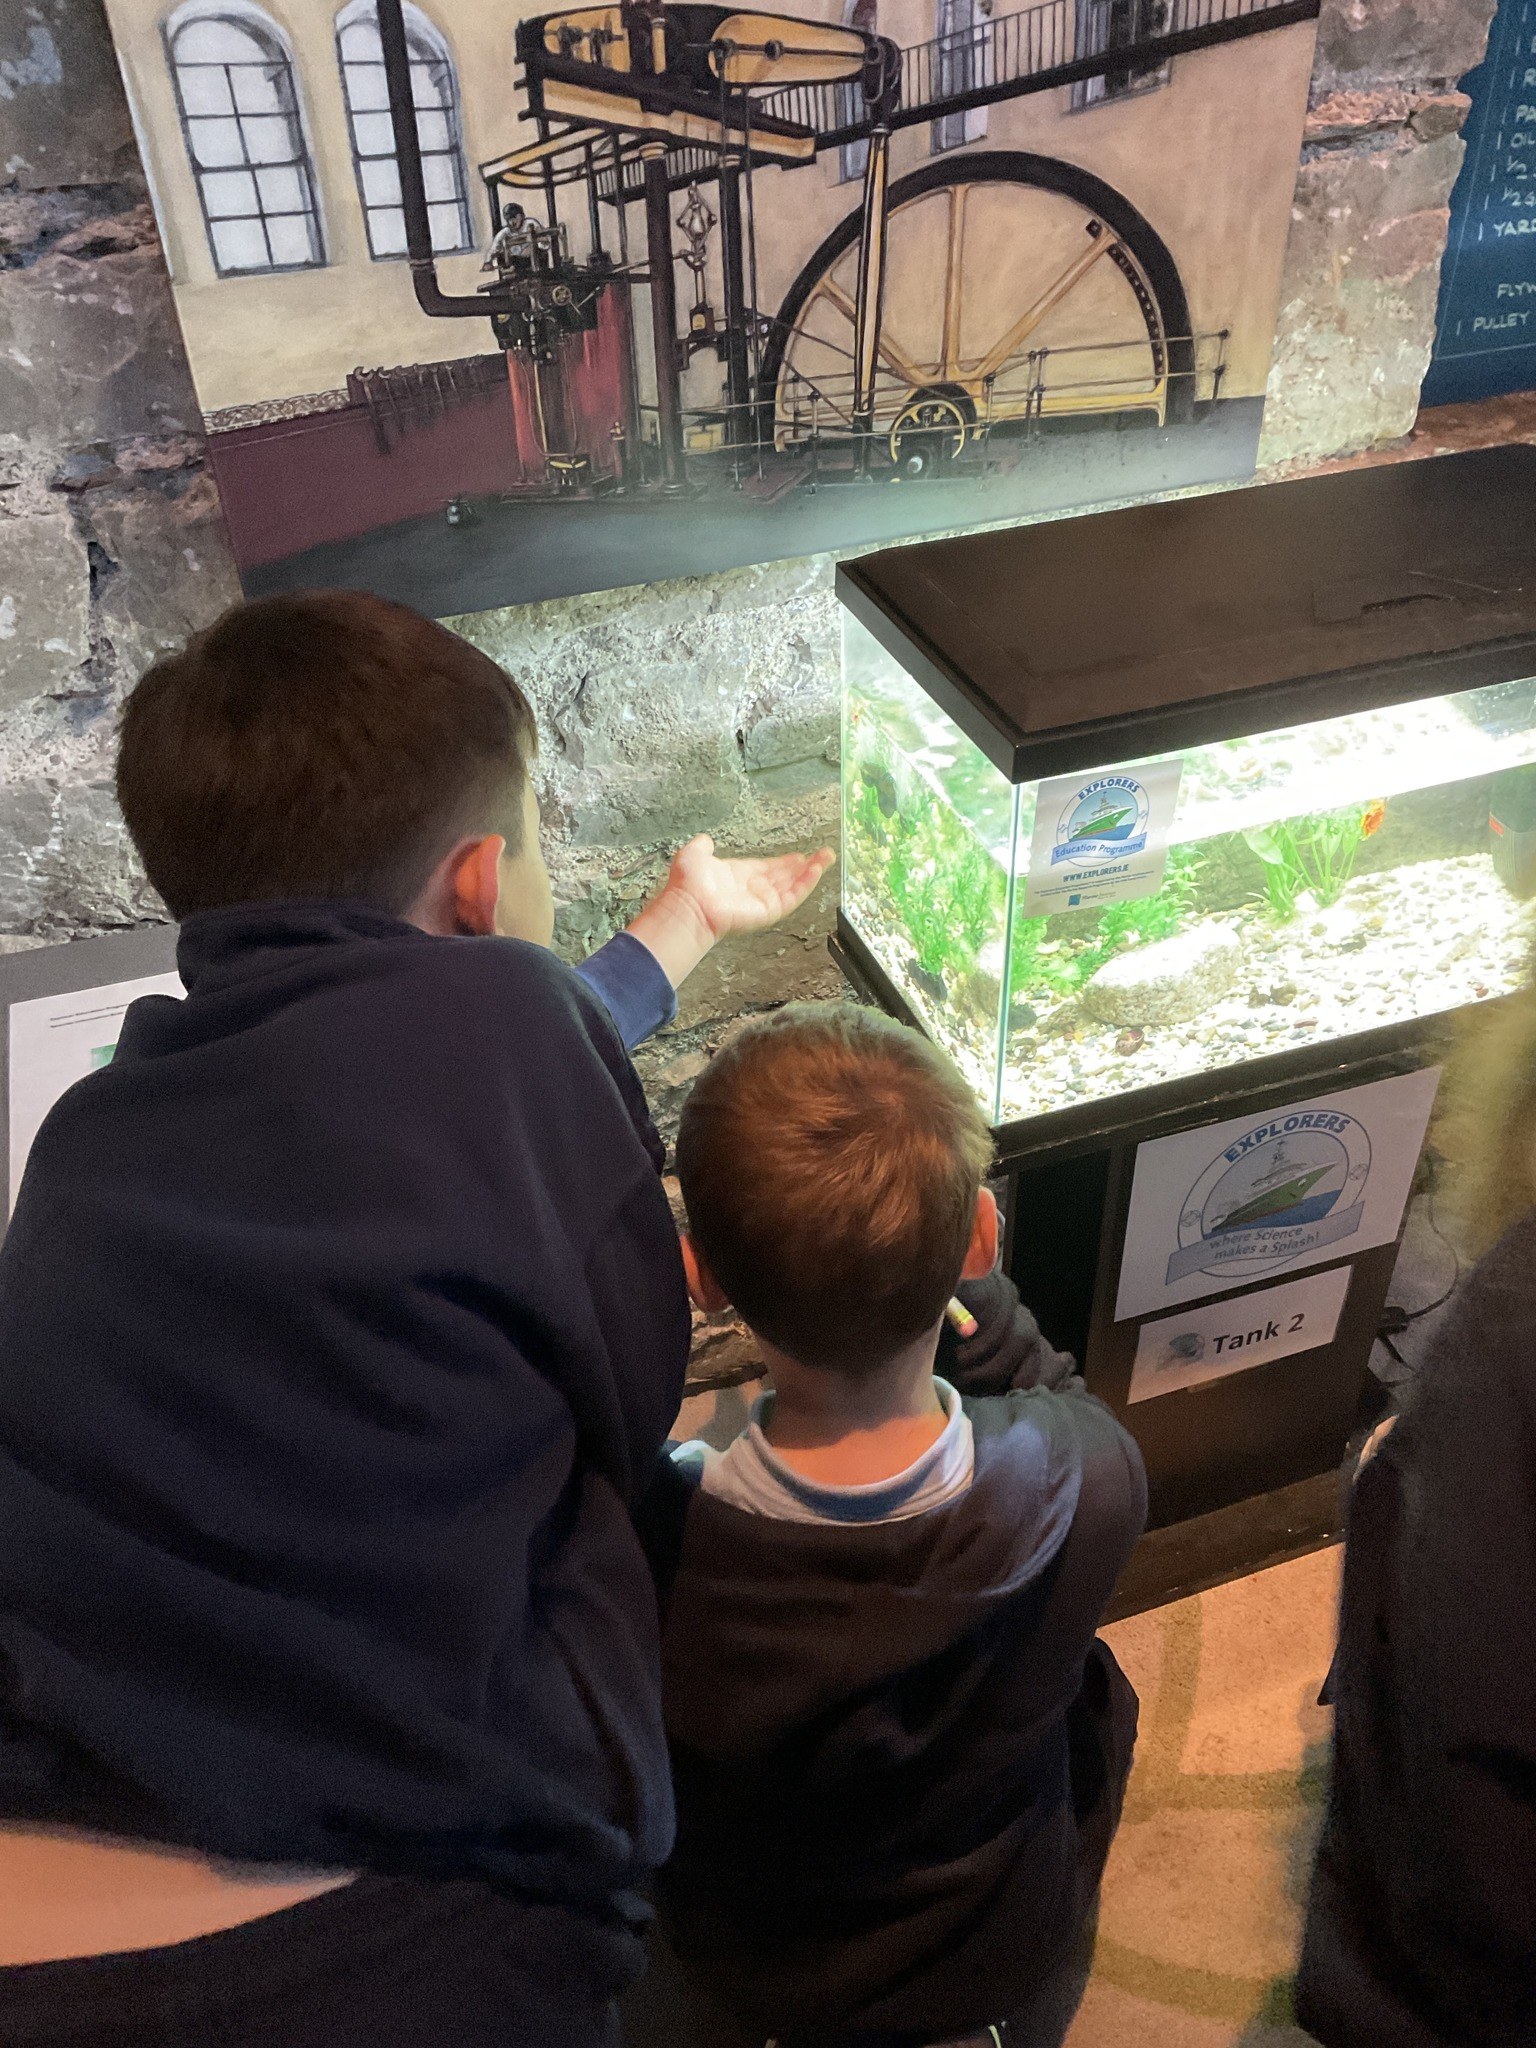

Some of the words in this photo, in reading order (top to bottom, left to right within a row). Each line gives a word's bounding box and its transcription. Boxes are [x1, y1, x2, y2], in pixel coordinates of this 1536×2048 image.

[1473, 310, 1530, 332] PULLEY
[1078, 778, 1140, 800] EXPLORERS
[1055, 843, 1097, 858] Education
[1098, 841, 1143, 856] Programme
[1063, 864, 1130, 882] WWW.EXPLORERS.IE
[1223, 1113, 1351, 1164] EXPLORERS
[1210, 1233, 1252, 1249] where
[1254, 1227, 1303, 1241] Science
[1214, 1244, 1257, 1259] makes
[1259, 1244, 1269, 1253] a
[1271, 1231, 1320, 1255] Splash!
[1212, 1321, 1278, 1354] Tank
[1287, 1312, 1305, 1334] 2
